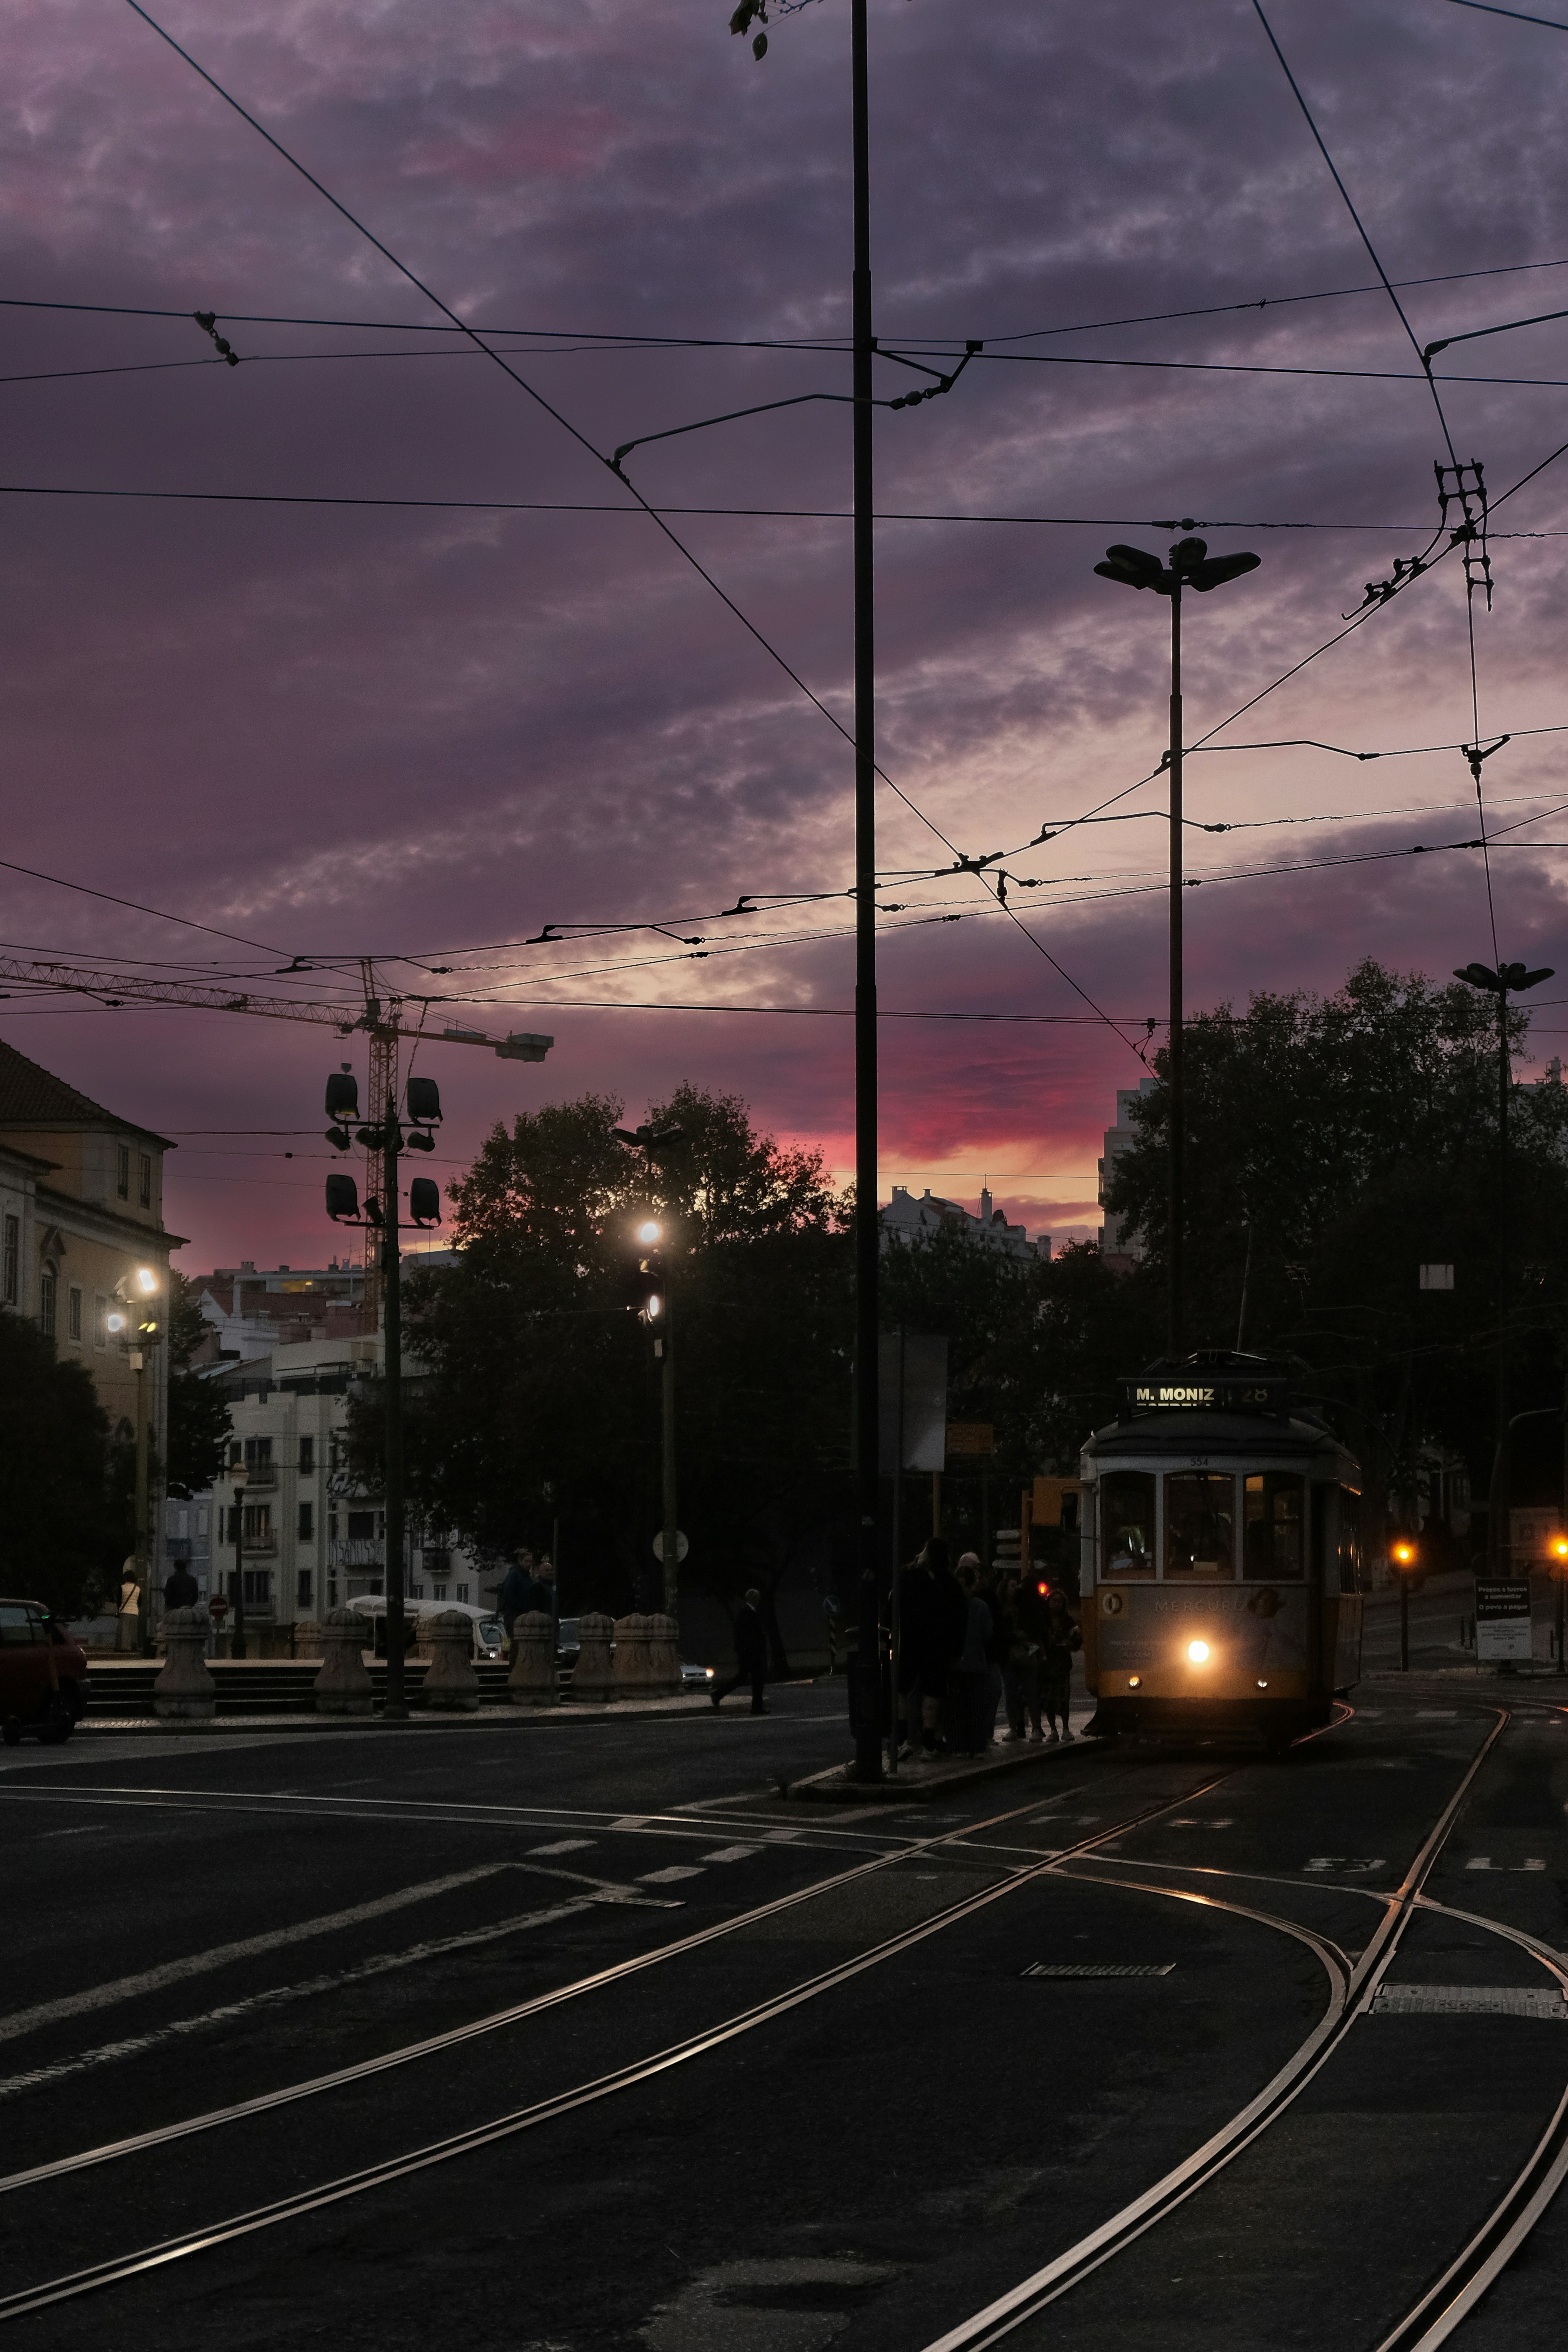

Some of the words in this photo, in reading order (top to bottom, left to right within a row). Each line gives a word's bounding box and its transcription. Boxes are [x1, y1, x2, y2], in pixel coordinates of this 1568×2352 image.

[1136, 1388, 1155, 1400] M.
[1160, 1388, 1215, 1400] MONIZ
[1191, 1458, 1208, 1466] 554
[1155, 1601, 1244, 1612] MERCURE
